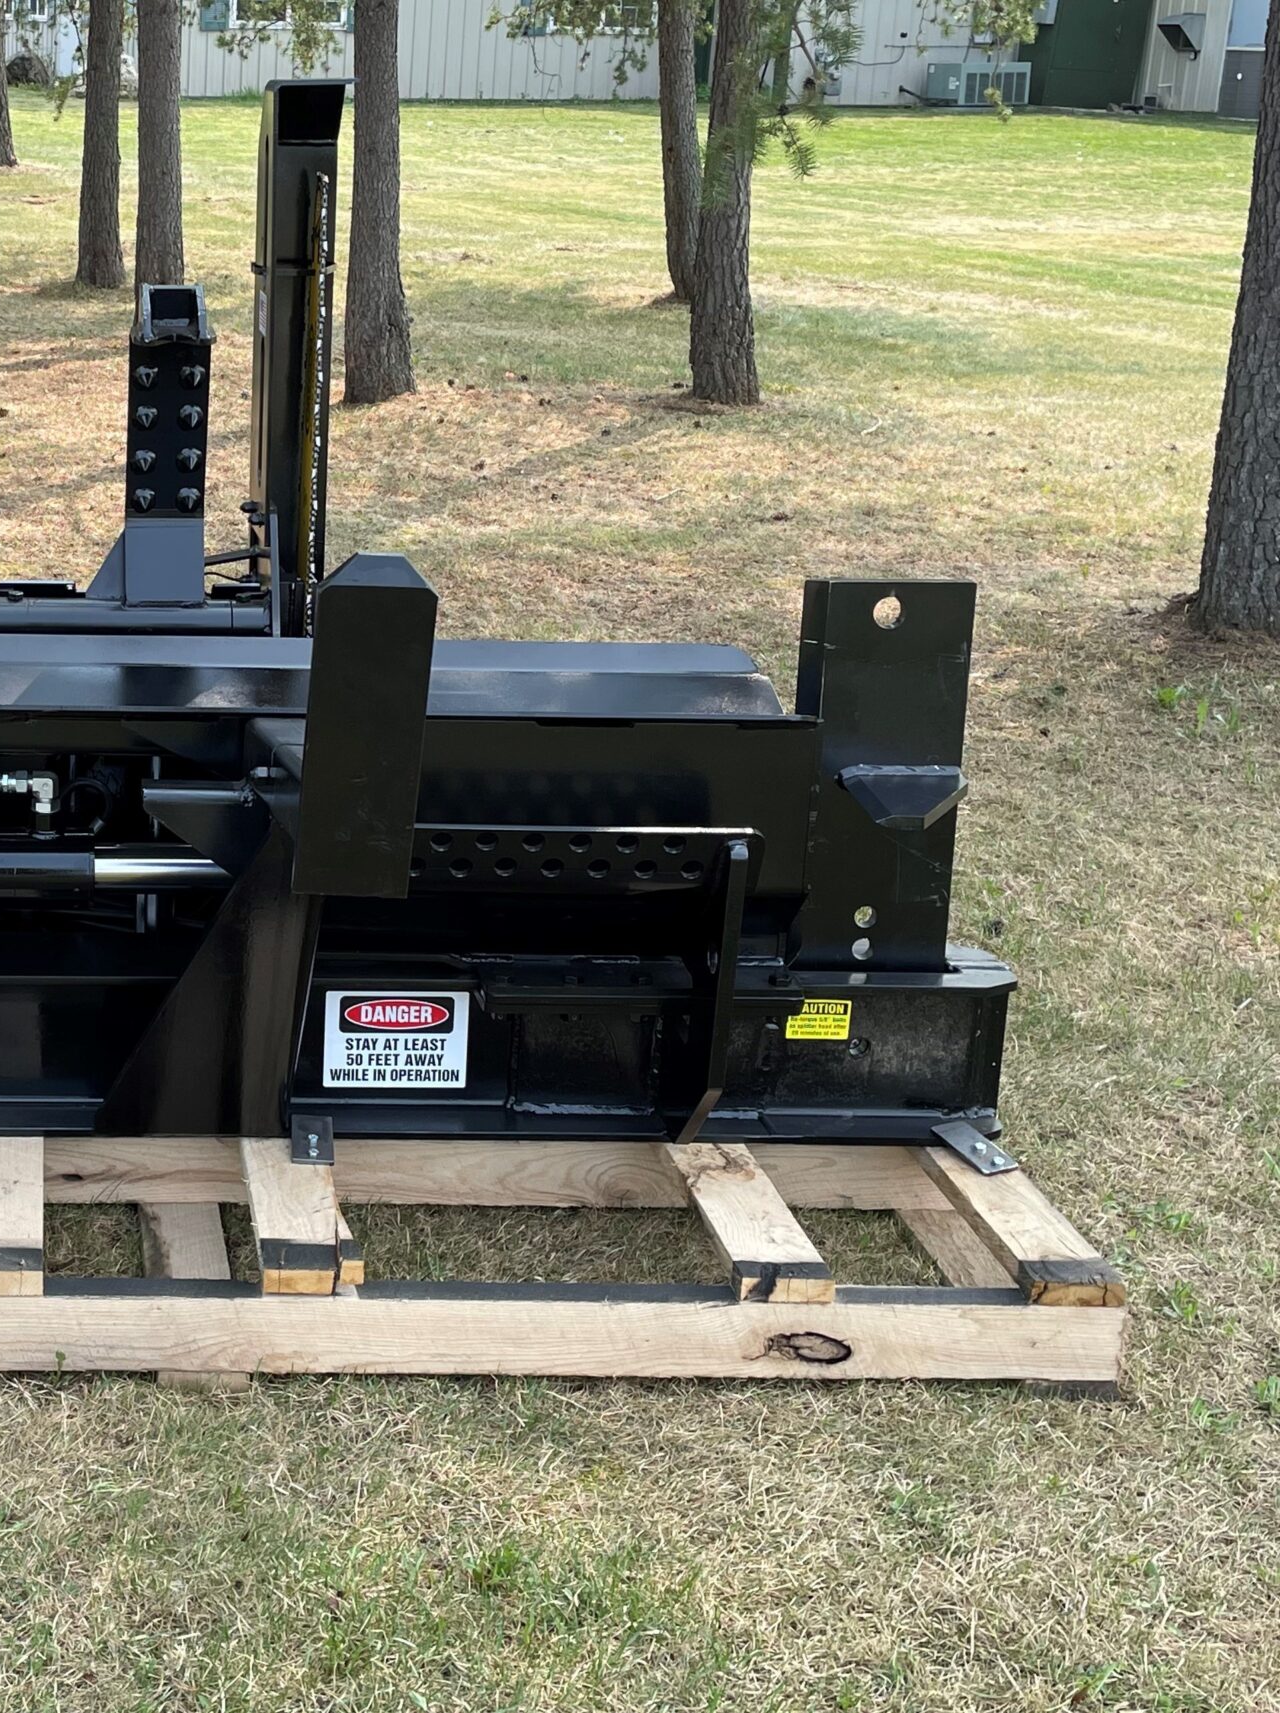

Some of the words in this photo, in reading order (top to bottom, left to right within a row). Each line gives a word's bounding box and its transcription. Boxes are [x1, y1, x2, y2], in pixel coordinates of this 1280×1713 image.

[360, 1005, 433, 1023] DANGER
[801, 1003, 845, 1014] AUTION
[345, 1038, 379, 1051] STAY
[383, 1038, 400, 1051] AT
[404, 1038, 447, 1051] LEAST
[346, 1053, 363, 1066] 50
[368, 1053, 400, 1066] FEET
[404, 1053, 444, 1066] AWAY
[330, 1068, 369, 1081] WHILE
[373, 1069, 386, 1082] IN
[390, 1069, 460, 1082] OPERATION
